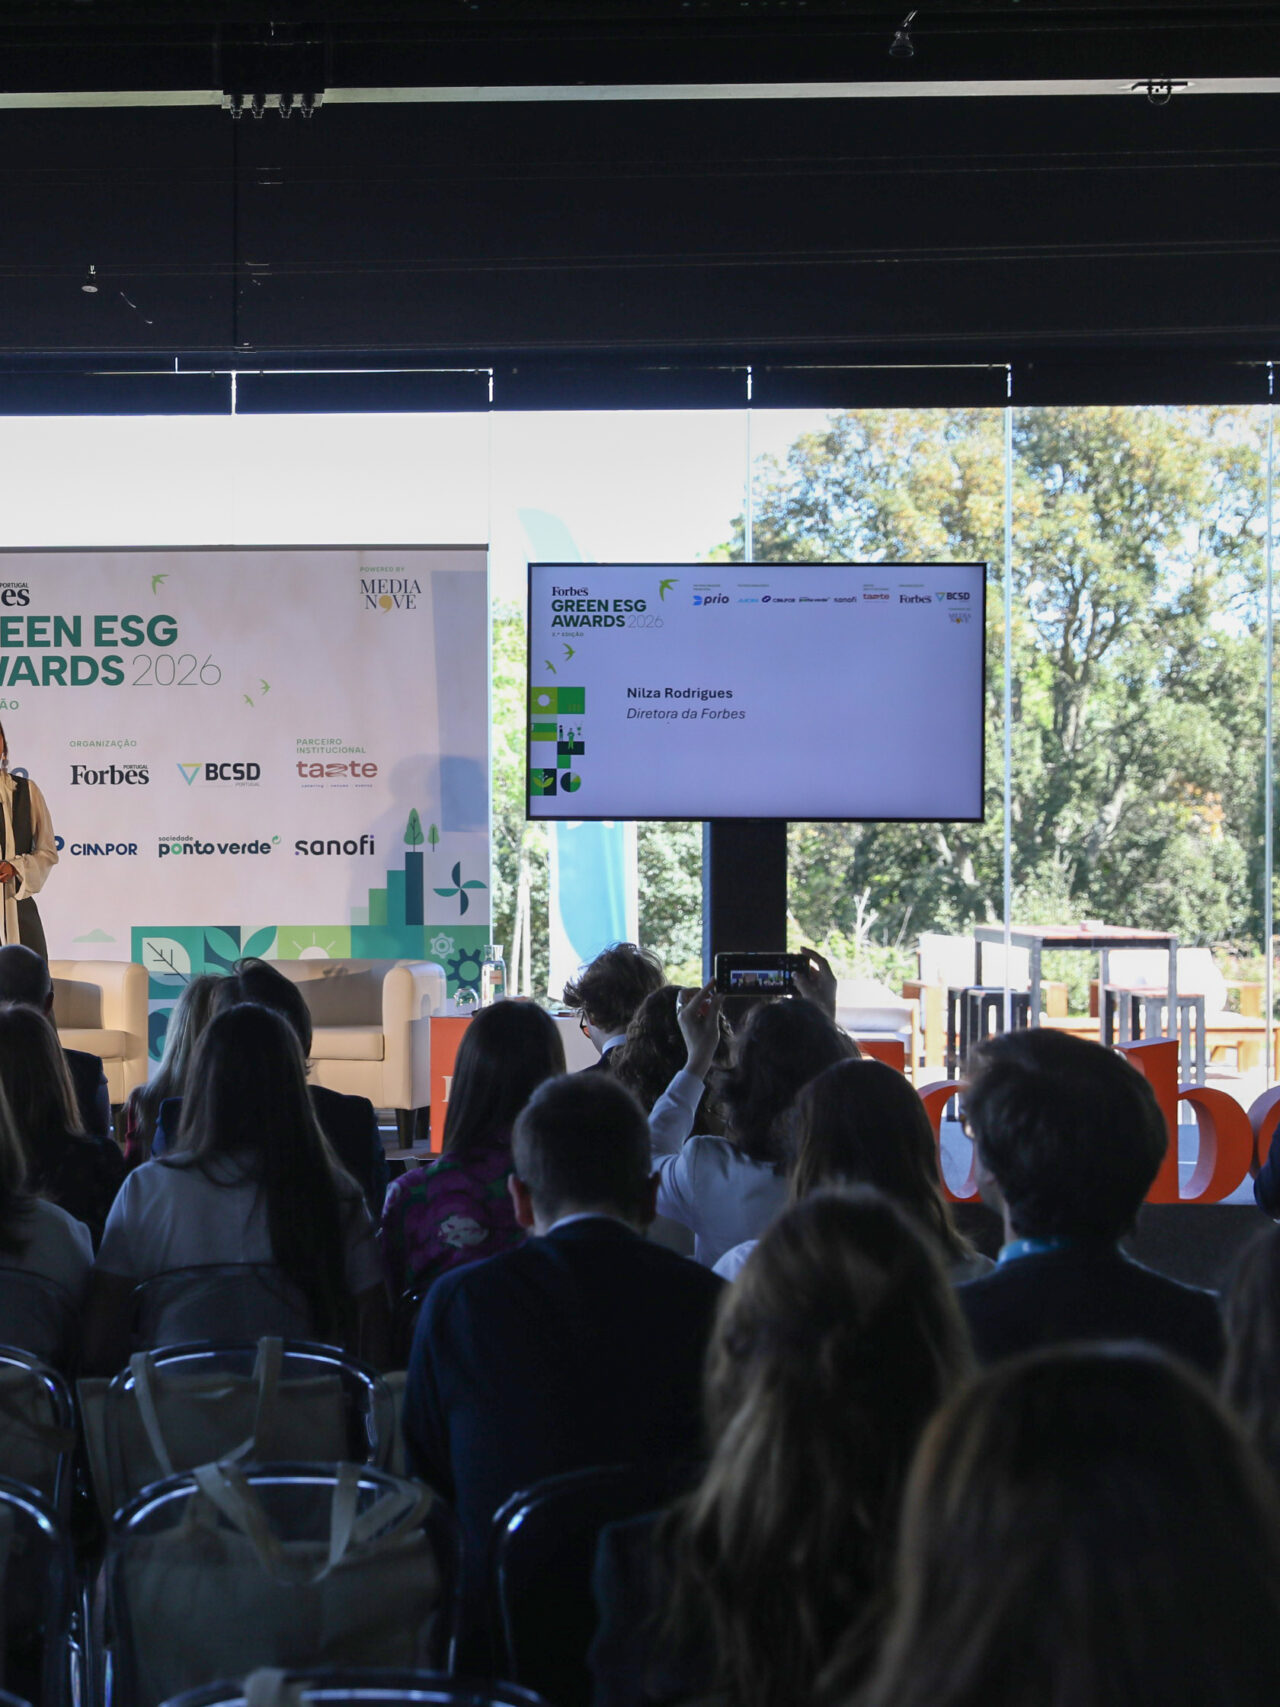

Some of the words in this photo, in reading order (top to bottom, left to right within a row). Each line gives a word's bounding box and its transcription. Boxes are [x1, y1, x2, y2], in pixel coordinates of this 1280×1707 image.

[360, 578, 422, 594] MEDIA
[552, 586, 589, 597] Forbes
[703, 593, 730, 606] prio
[899, 594, 932, 604] Forbes
[946, 591, 970, 600] BCSD
[551, 599, 609, 613] GREEN
[613, 599, 647, 613] ESG
[551, 615, 626, 628] AWARDS
[628, 614, 665, 629] 2026
[94, 614, 179, 648] ESG
[132, 653, 222, 686] 2026
[627, 687, 661, 699] Nilza
[664, 687, 733, 701] Rodrigues
[626, 707, 678, 720] Diretora
[681, 708, 698, 720] da
[701, 708, 746, 720] Forbes
[69, 739, 137, 749] ORGANIZAÇÃO
[296, 738, 343, 746] PARCEIRO
[296, 746, 367, 754] INSTITUCIONAL
[70, 764, 150, 785] Forbes
[205, 762, 261, 781] BCSD
[70, 842, 139, 856] CIMPOR
[158, 840, 216, 858] ponto
[216, 839, 272, 856] verde
[294, 834, 376, 856] sanofi
